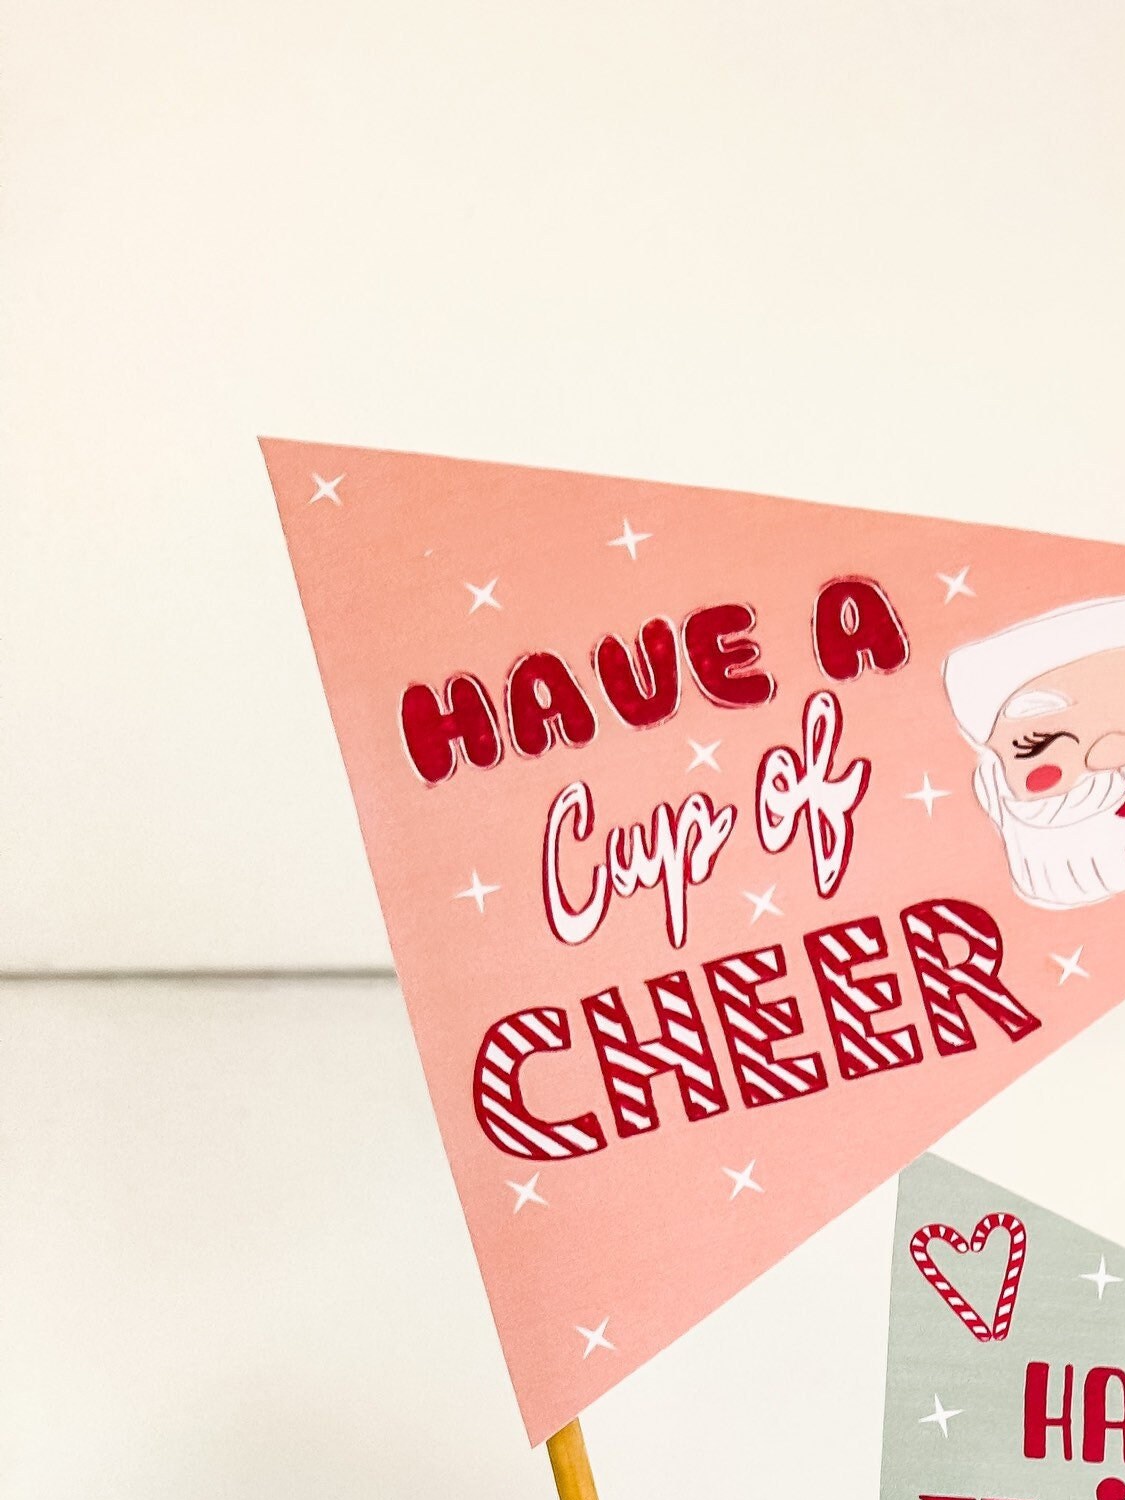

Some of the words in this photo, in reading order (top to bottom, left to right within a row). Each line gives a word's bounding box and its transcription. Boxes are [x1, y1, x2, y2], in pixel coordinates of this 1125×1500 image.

[397, 602, 776, 788] HAVE
[810, 574, 911, 681] A
[541, 780, 737, 949] Cup
[755, 690, 871, 900] of
[472, 898, 1042, 1161] CHEER
